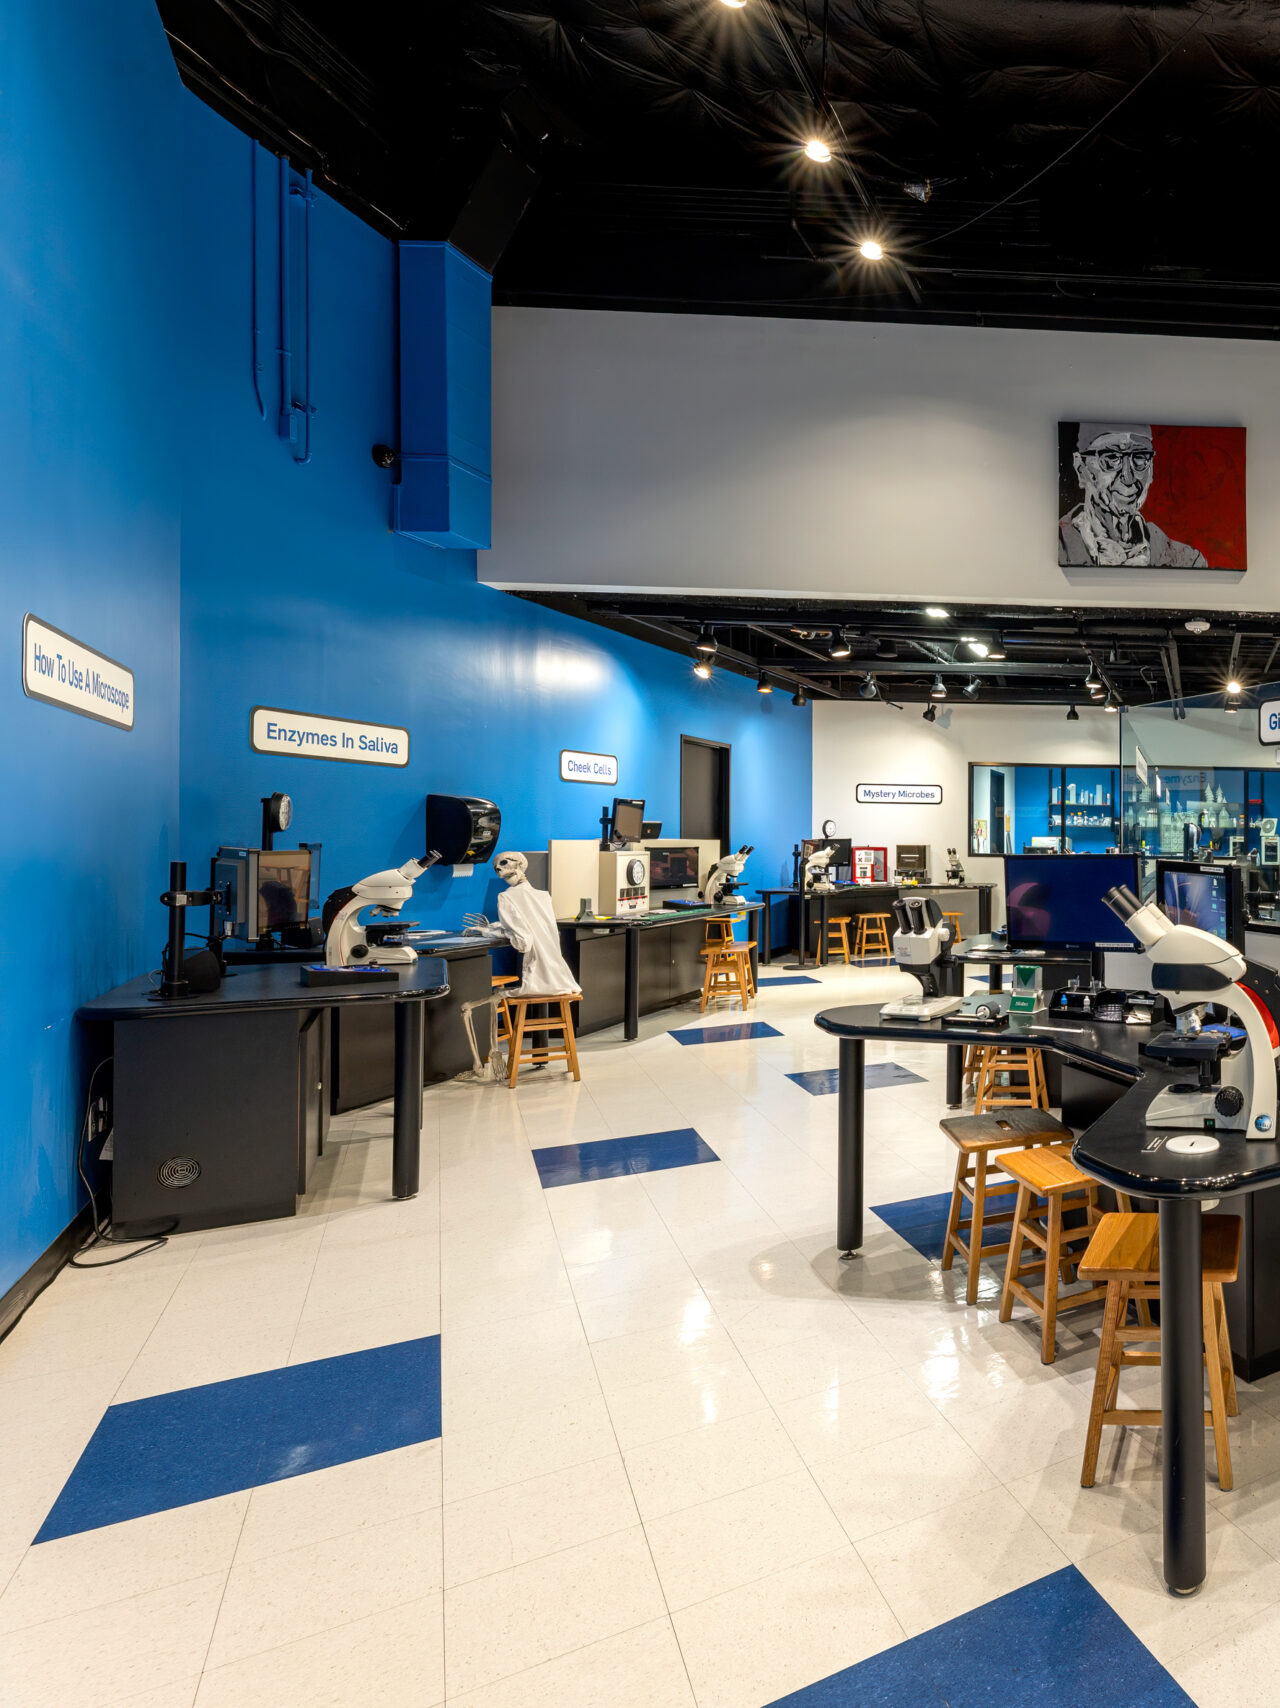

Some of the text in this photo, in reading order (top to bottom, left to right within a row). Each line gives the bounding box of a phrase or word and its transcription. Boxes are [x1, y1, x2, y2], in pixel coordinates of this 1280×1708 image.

[34, 642, 129, 713] How To Use A Microscope
[266, 722, 398, 754] Enzymes In Saliva
[567, 759, 612, 776] Cheek Cells
[863, 789, 935, 799] Mystery Microbes
